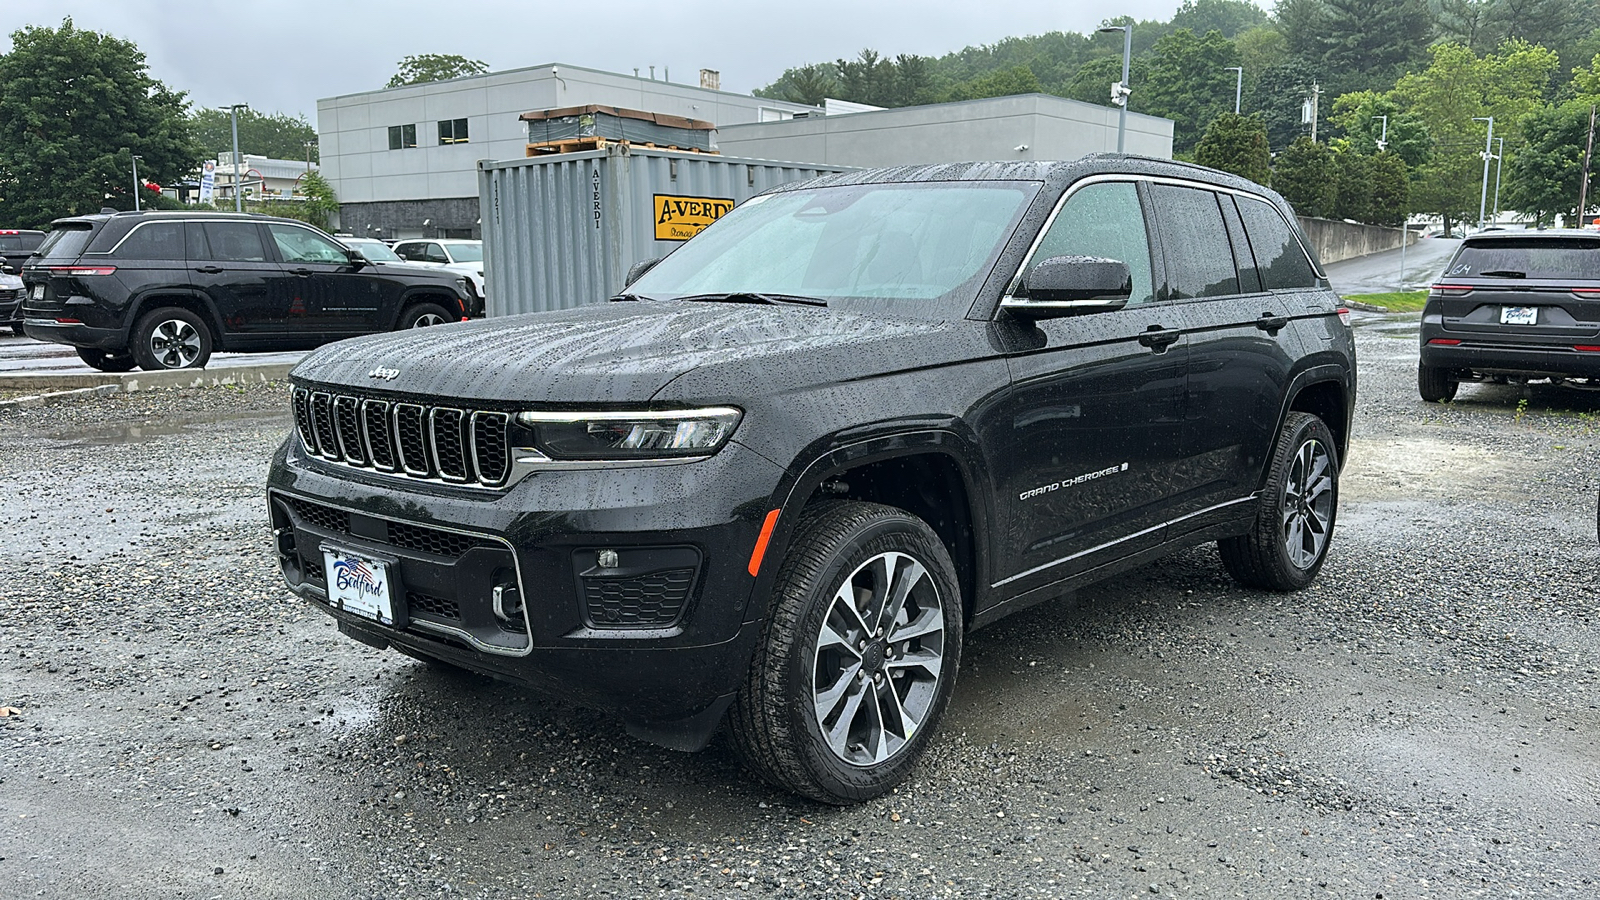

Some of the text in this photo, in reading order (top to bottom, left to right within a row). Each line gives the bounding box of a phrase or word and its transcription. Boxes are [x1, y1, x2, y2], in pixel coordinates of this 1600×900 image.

[368, 364, 400, 382] Jeep
[1019, 466, 1119, 500] GRAND CHEROKEE
[333, 560, 384, 599] Bedford
